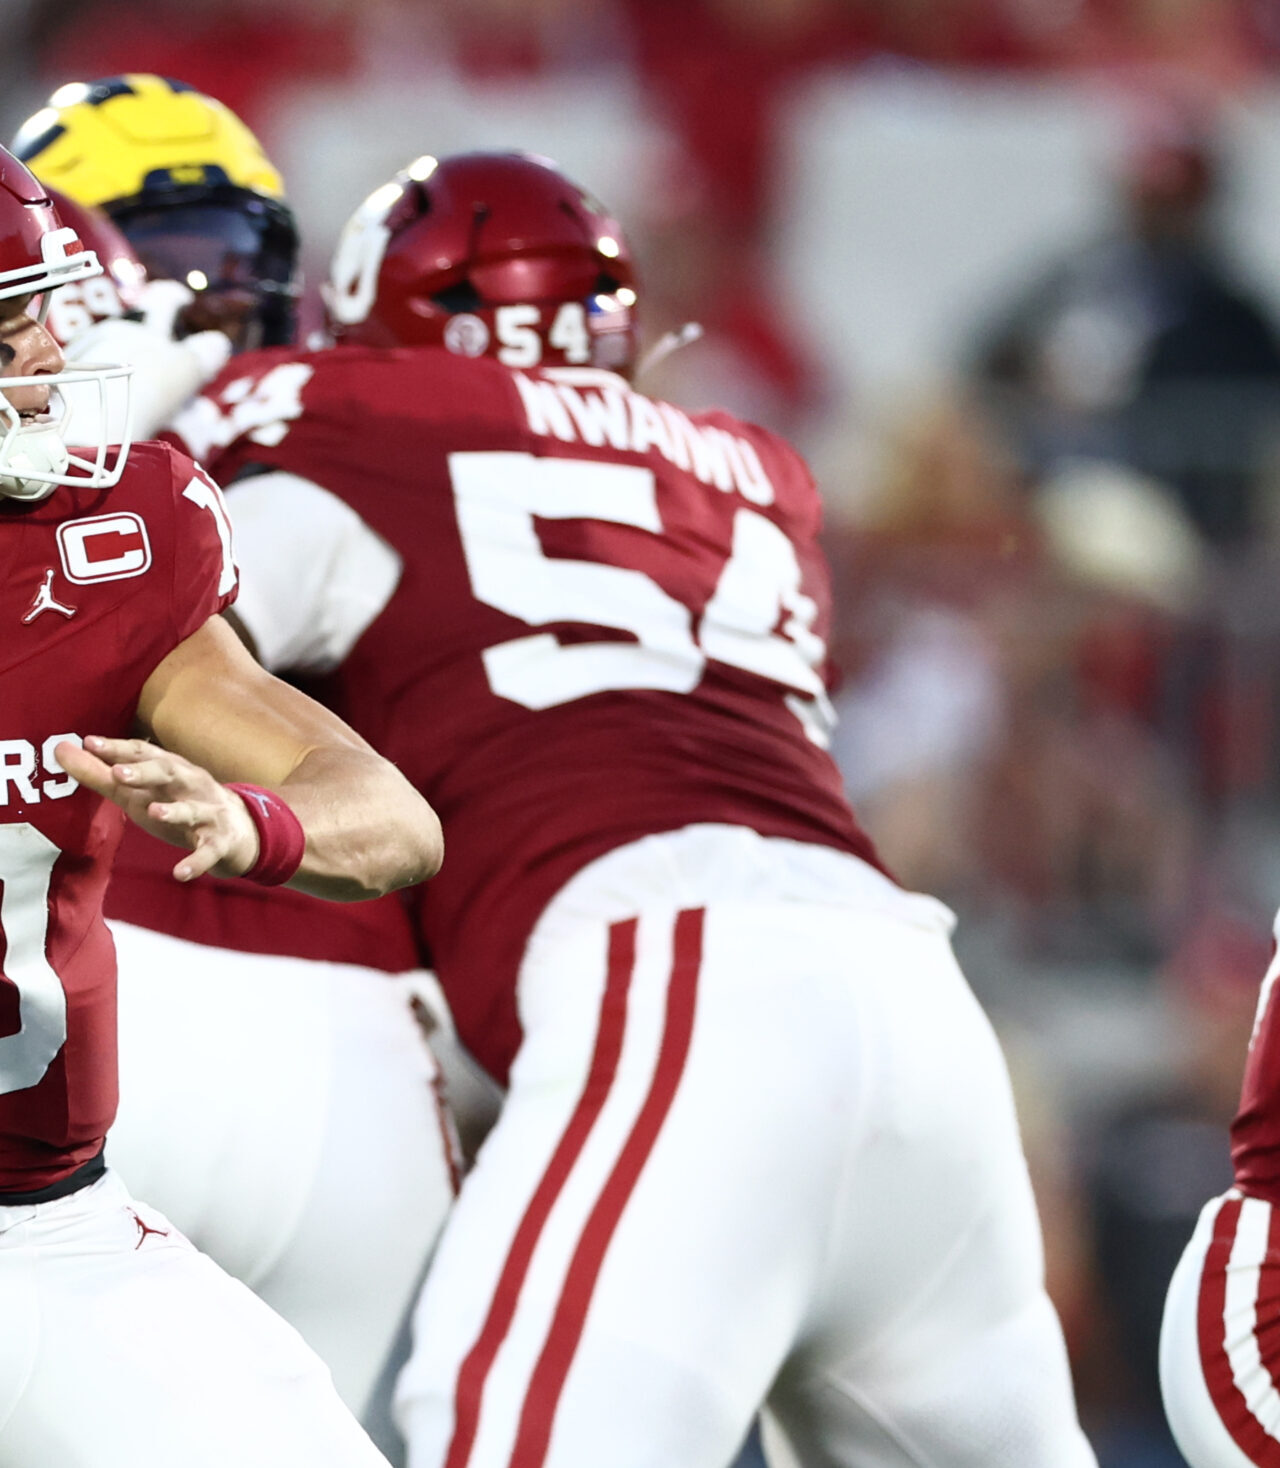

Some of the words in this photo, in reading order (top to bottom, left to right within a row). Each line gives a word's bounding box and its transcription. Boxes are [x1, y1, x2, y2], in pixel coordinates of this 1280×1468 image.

[495, 302, 590, 367] 54
[62, 518, 145, 578] C
[447, 450, 839, 749] 54
